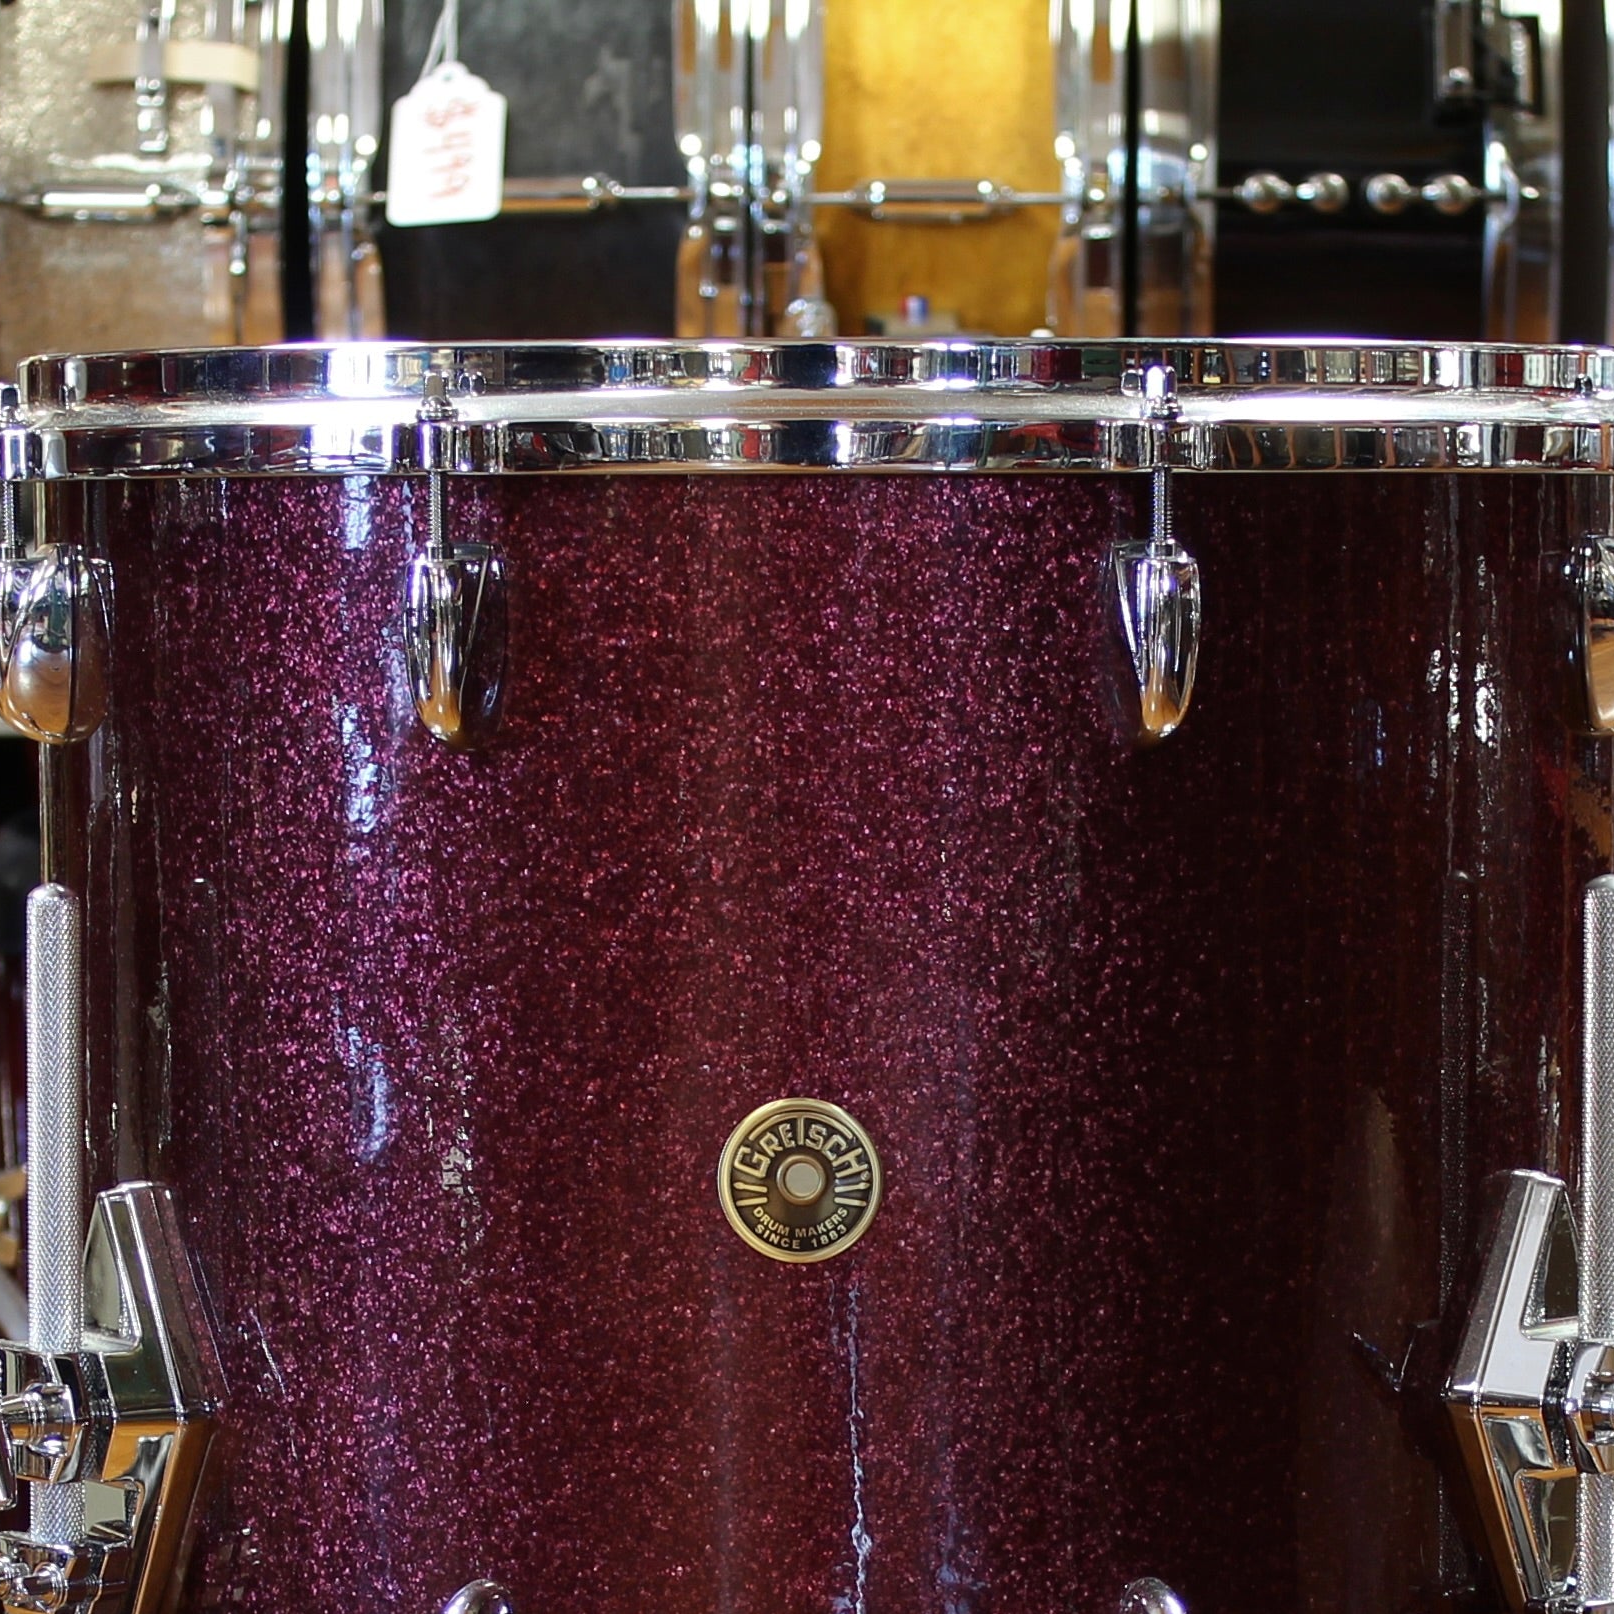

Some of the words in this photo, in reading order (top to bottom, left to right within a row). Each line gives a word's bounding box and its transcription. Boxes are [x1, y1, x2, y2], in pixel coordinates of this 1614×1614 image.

[422, 98, 480, 199] $499
[734, 1113, 868, 1178] GRETSCH
[753, 1206, 789, 1235] DRUM
[796, 1206, 848, 1237] MAKERS
[755, 1224, 800, 1249] SINCE
[812, 1224, 847, 1248] 1883
